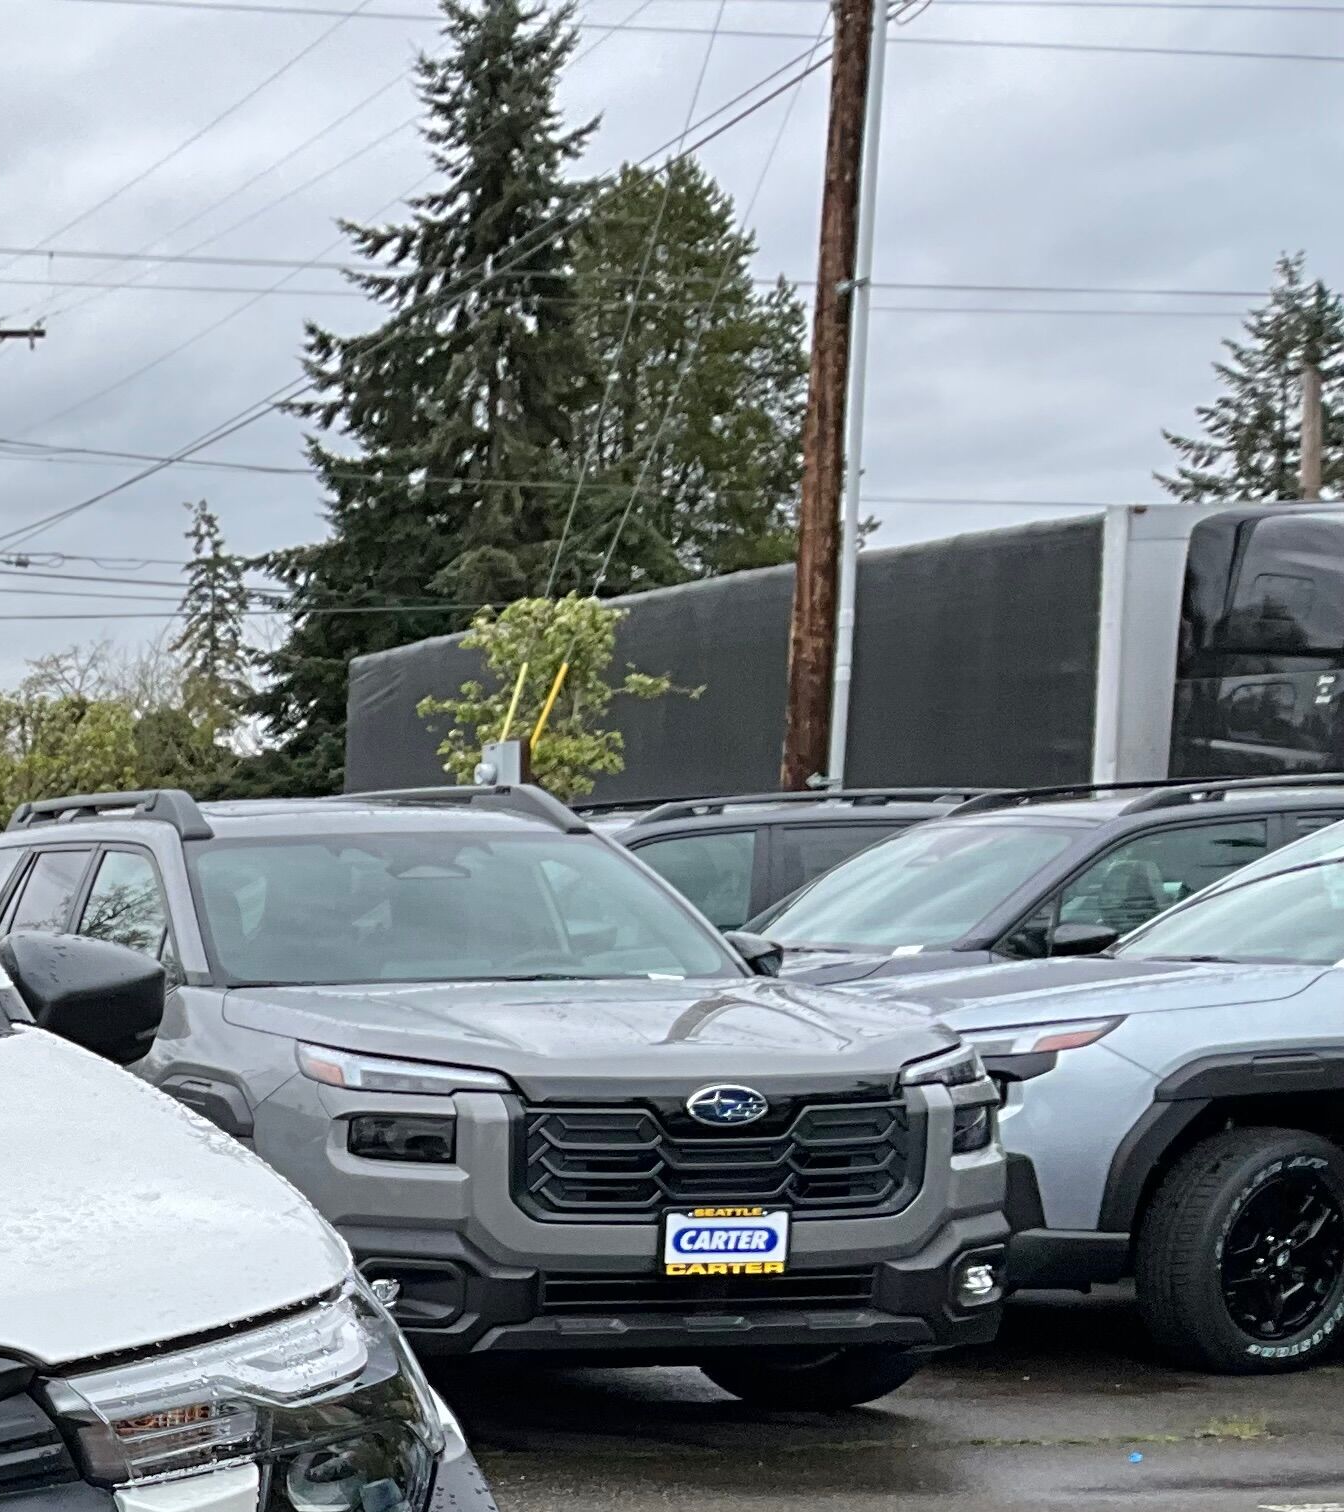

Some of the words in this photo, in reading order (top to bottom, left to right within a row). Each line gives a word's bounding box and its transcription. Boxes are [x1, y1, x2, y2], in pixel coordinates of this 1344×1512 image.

[693, 1207, 762, 1218] SEATTLE
[679, 1229, 770, 1251] CARTER
[665, 1261, 785, 1276] CARTER
